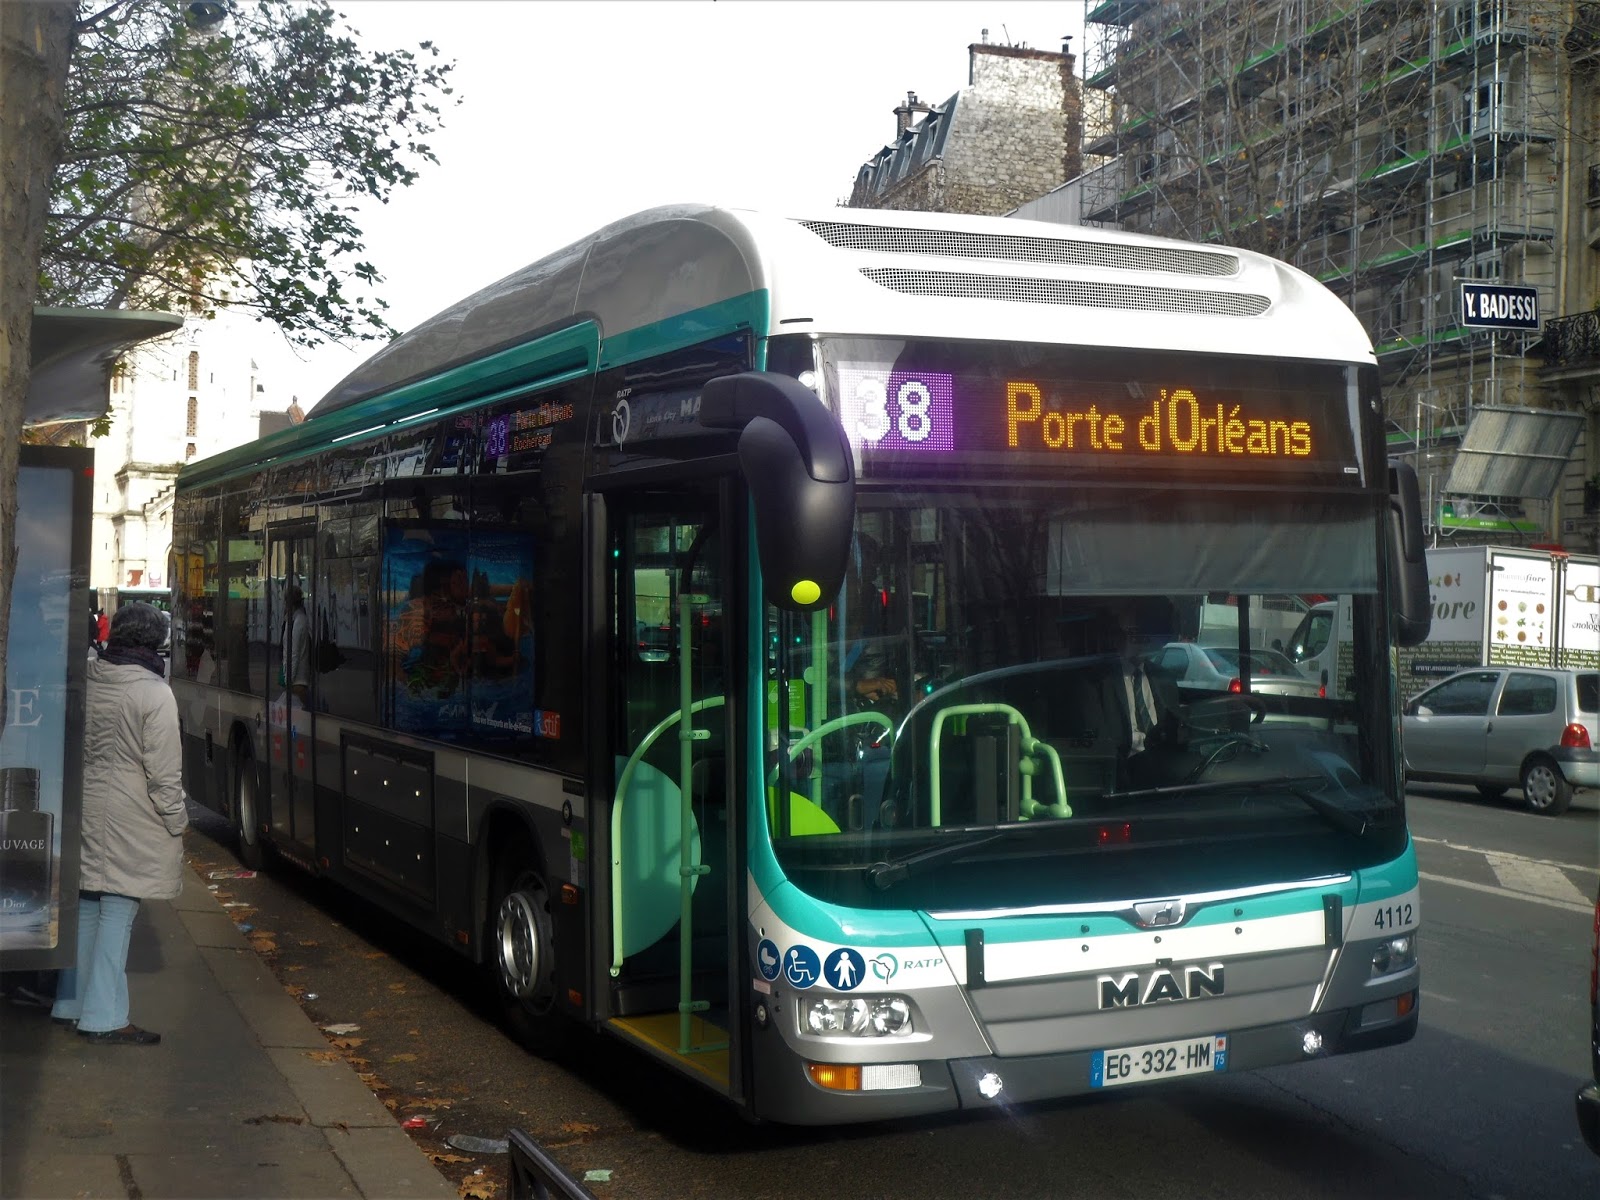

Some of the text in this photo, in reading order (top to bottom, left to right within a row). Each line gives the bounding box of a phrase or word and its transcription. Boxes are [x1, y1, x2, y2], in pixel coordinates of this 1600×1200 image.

[1465, 292, 1536, 321] Y. BADESSI
[616, 387, 632, 399] RATP
[680, 396, 702, 417] MA
[854, 376, 931, 442] 38
[1006, 381, 1312, 456] Porte d'Orléans
[1430, 594, 1476, 620] iore
[0, 839, 45, 850] UVAGE
[3, 898, 27, 908] Dior
[1374, 903, 1413, 930] 4112
[903, 958, 944, 970] RATP
[1097, 963, 1225, 1010] MAN
[1106, 1043, 1211, 1080] EG-332-HM
[1215, 1053, 1226, 1066] 75
[1094, 1072, 1100, 1081] F
